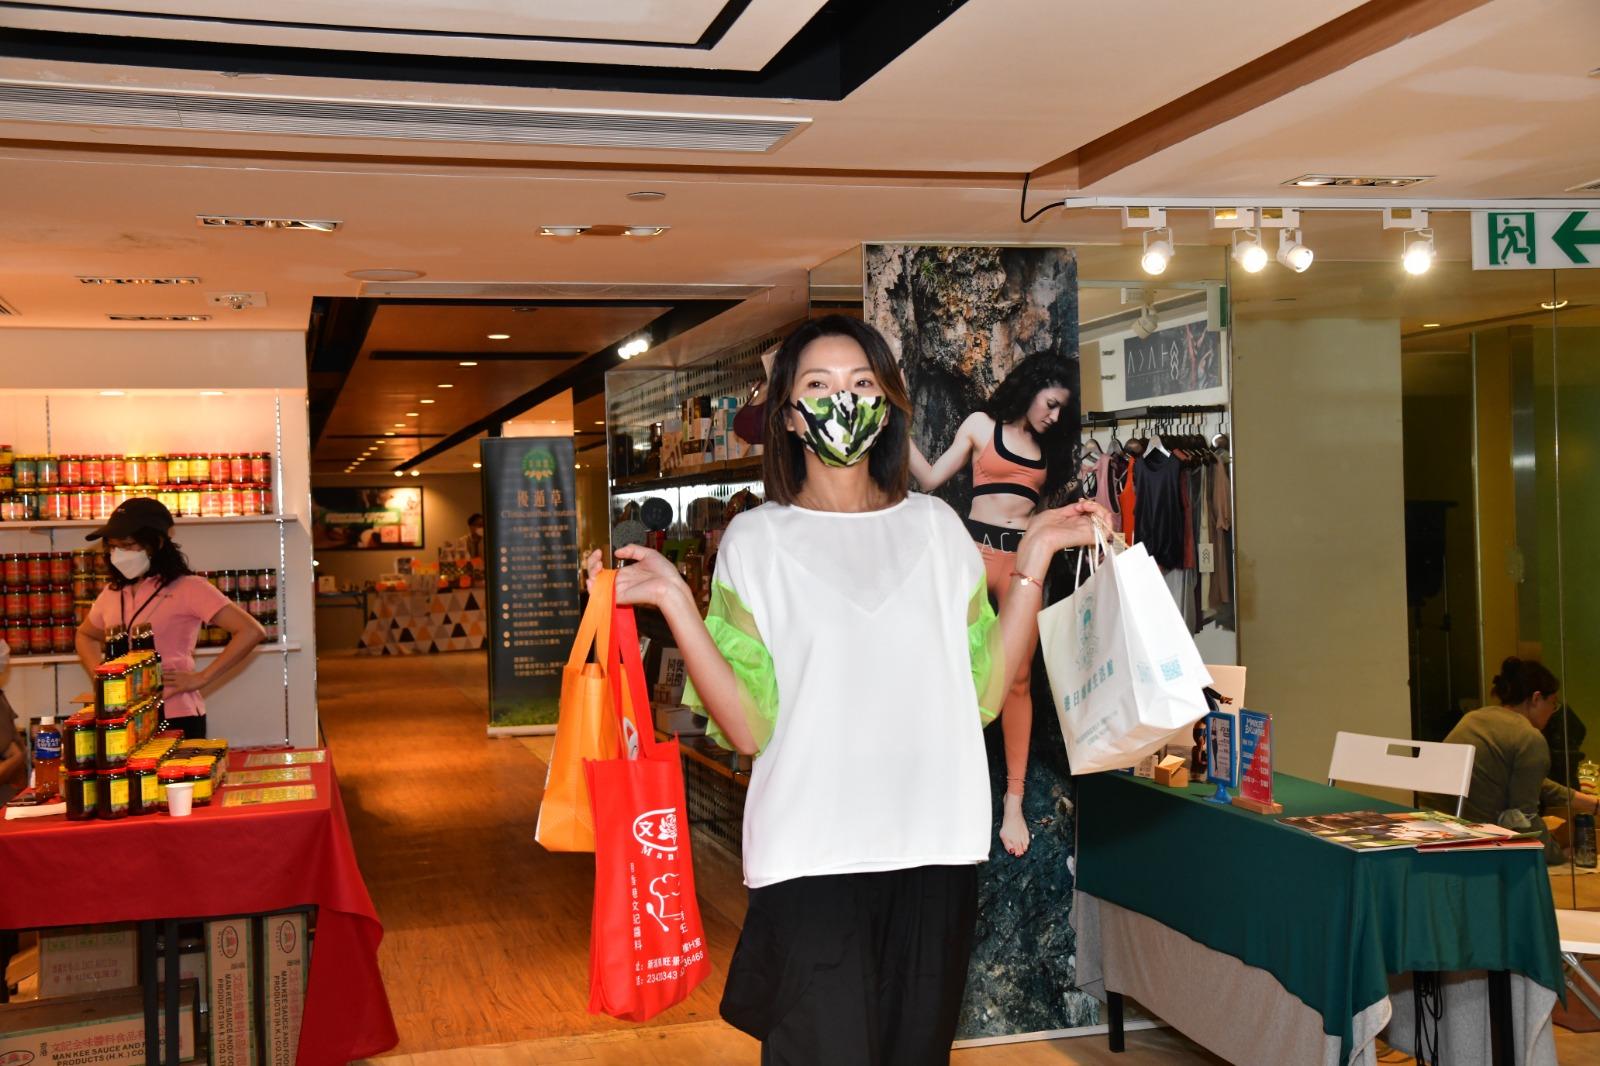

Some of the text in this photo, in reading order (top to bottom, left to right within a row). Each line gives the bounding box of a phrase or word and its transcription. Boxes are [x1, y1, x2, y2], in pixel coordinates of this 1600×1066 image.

[638, 820, 654, 837] 文
[52, 1053, 72, 1061] MAN
[73, 1049, 90, 1058] KEE
[91, 1045, 121, 1055] SAUCE
[122, 1042, 141, 1051] AND
